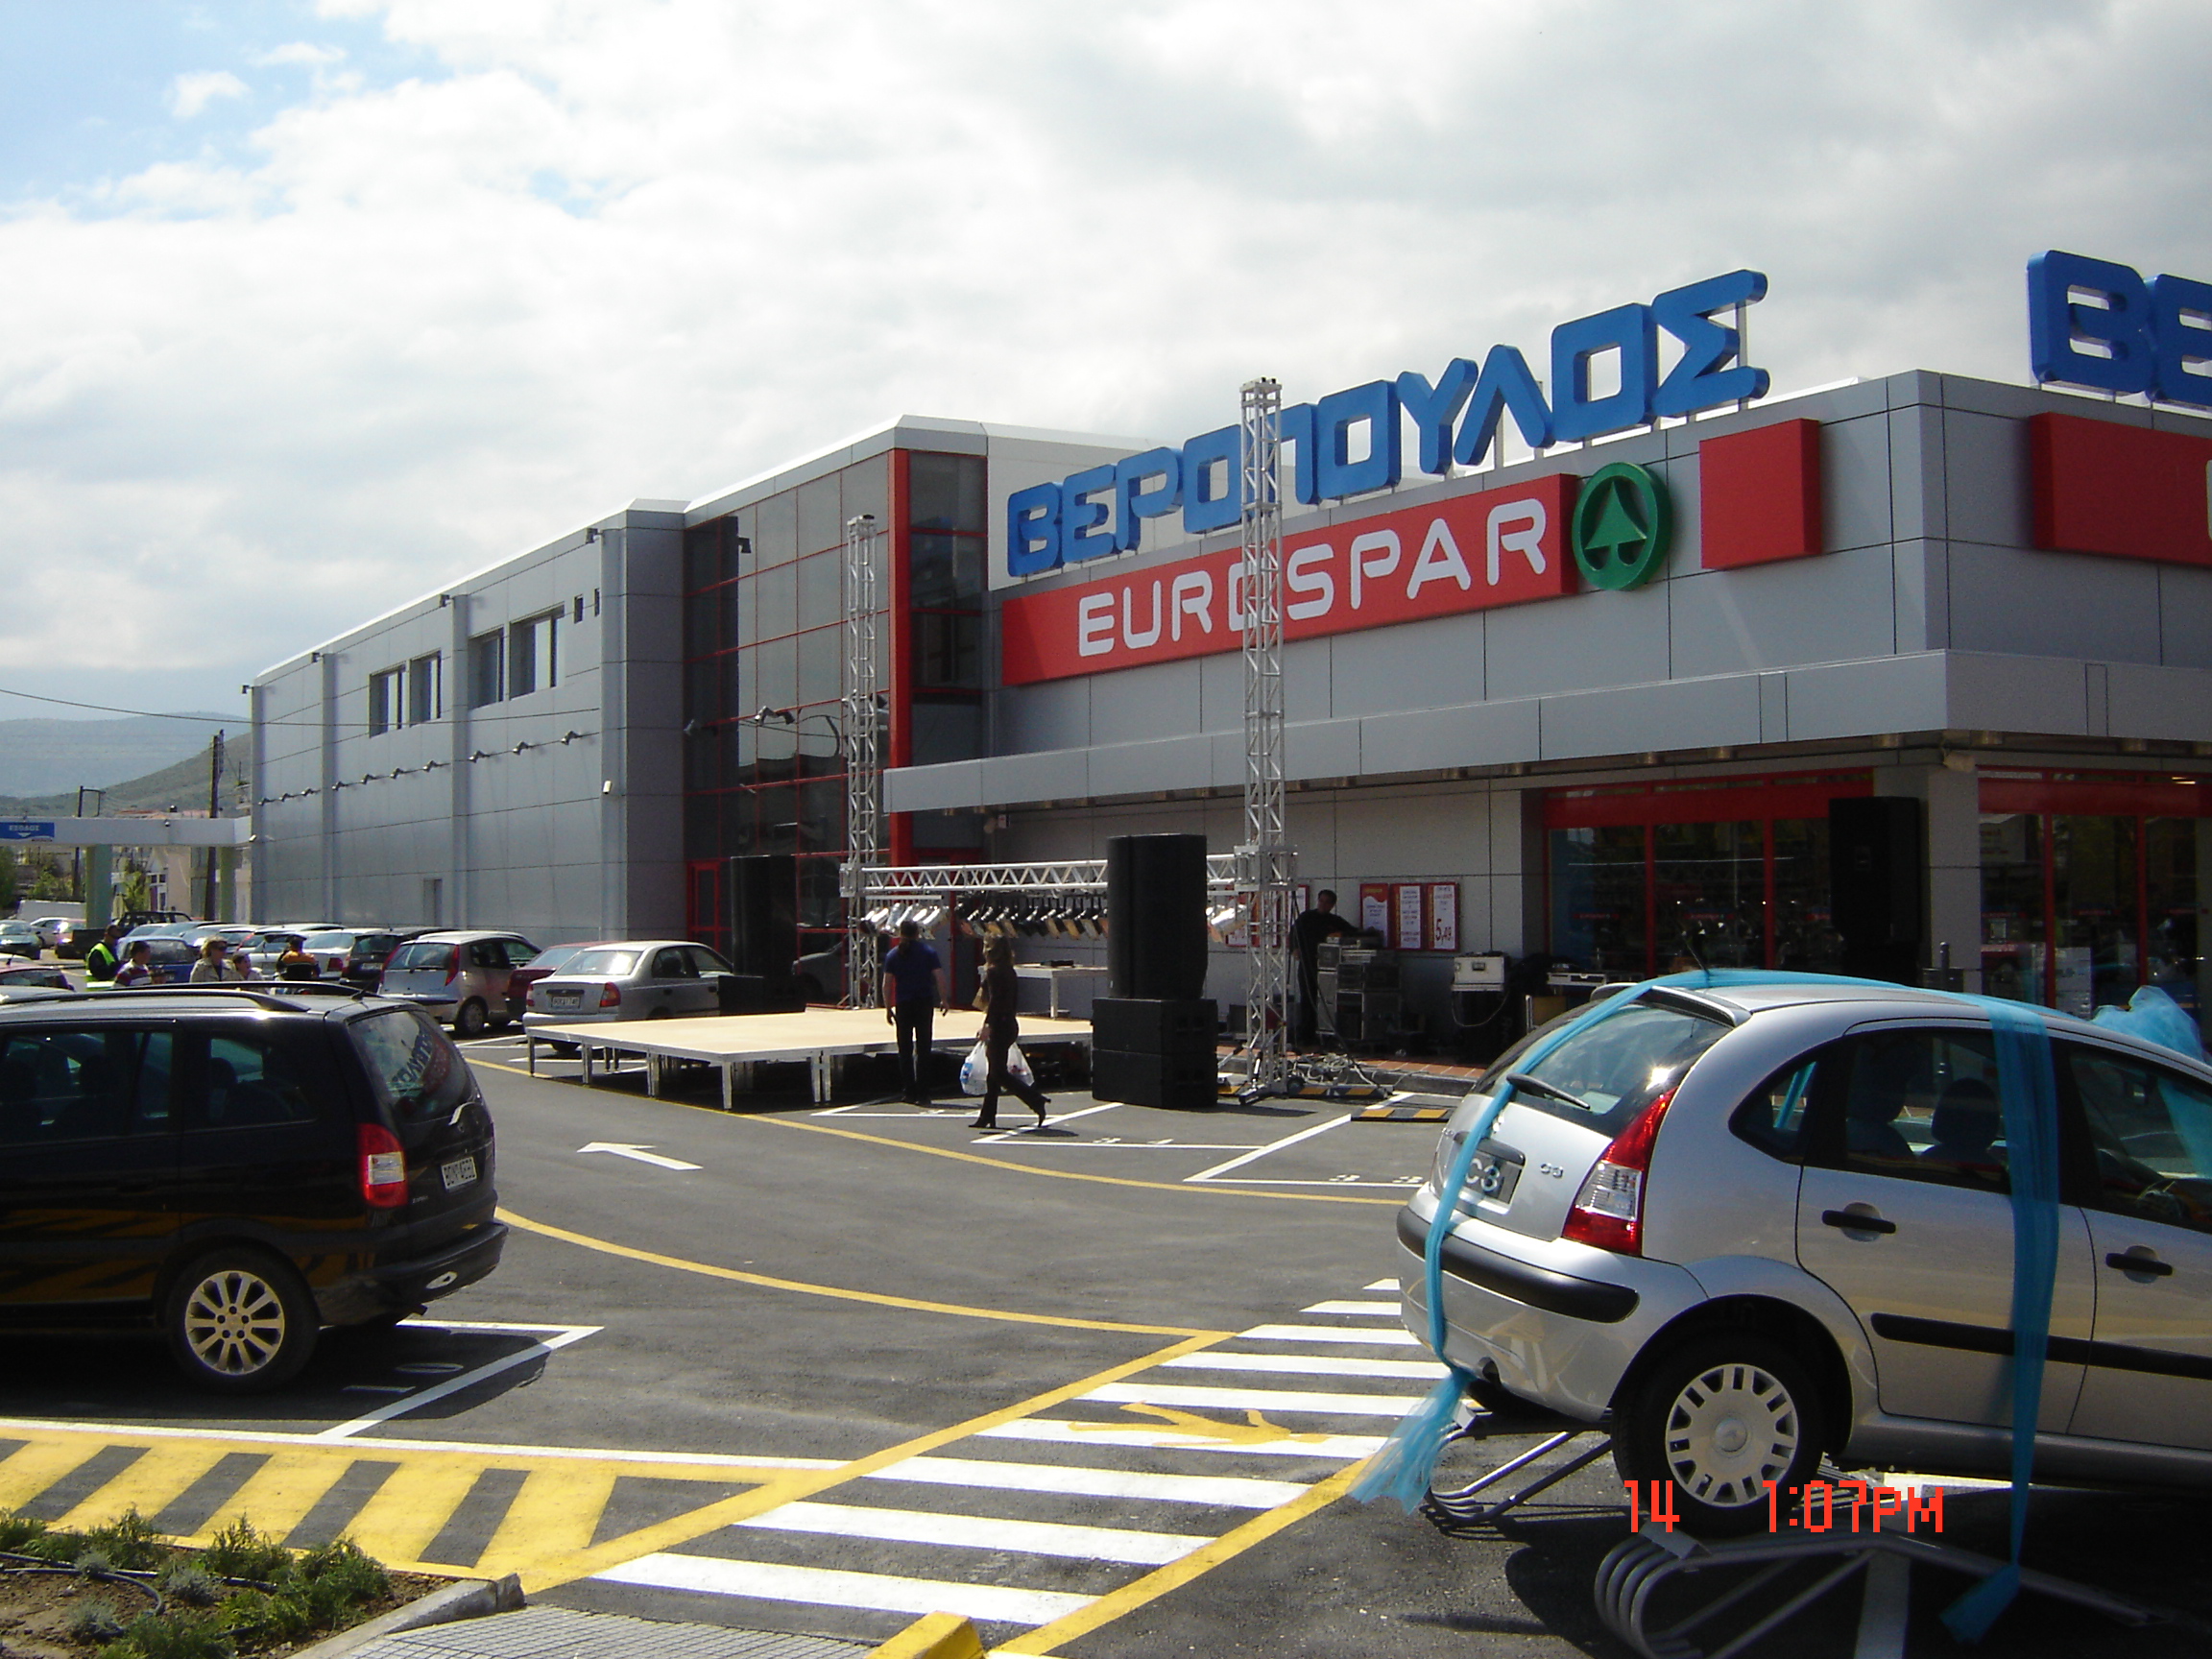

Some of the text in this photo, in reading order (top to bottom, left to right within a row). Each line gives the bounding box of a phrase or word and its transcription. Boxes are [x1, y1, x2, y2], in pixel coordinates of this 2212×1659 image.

[1008, 269, 1769, 577] ΒΕΡΟΠΟΥΛΟΣ
[1078, 498, 1547, 657] EUROSPAR
[1465, 1158, 1501, 1191] C3
[1540, 1163, 1564, 1178] C3
